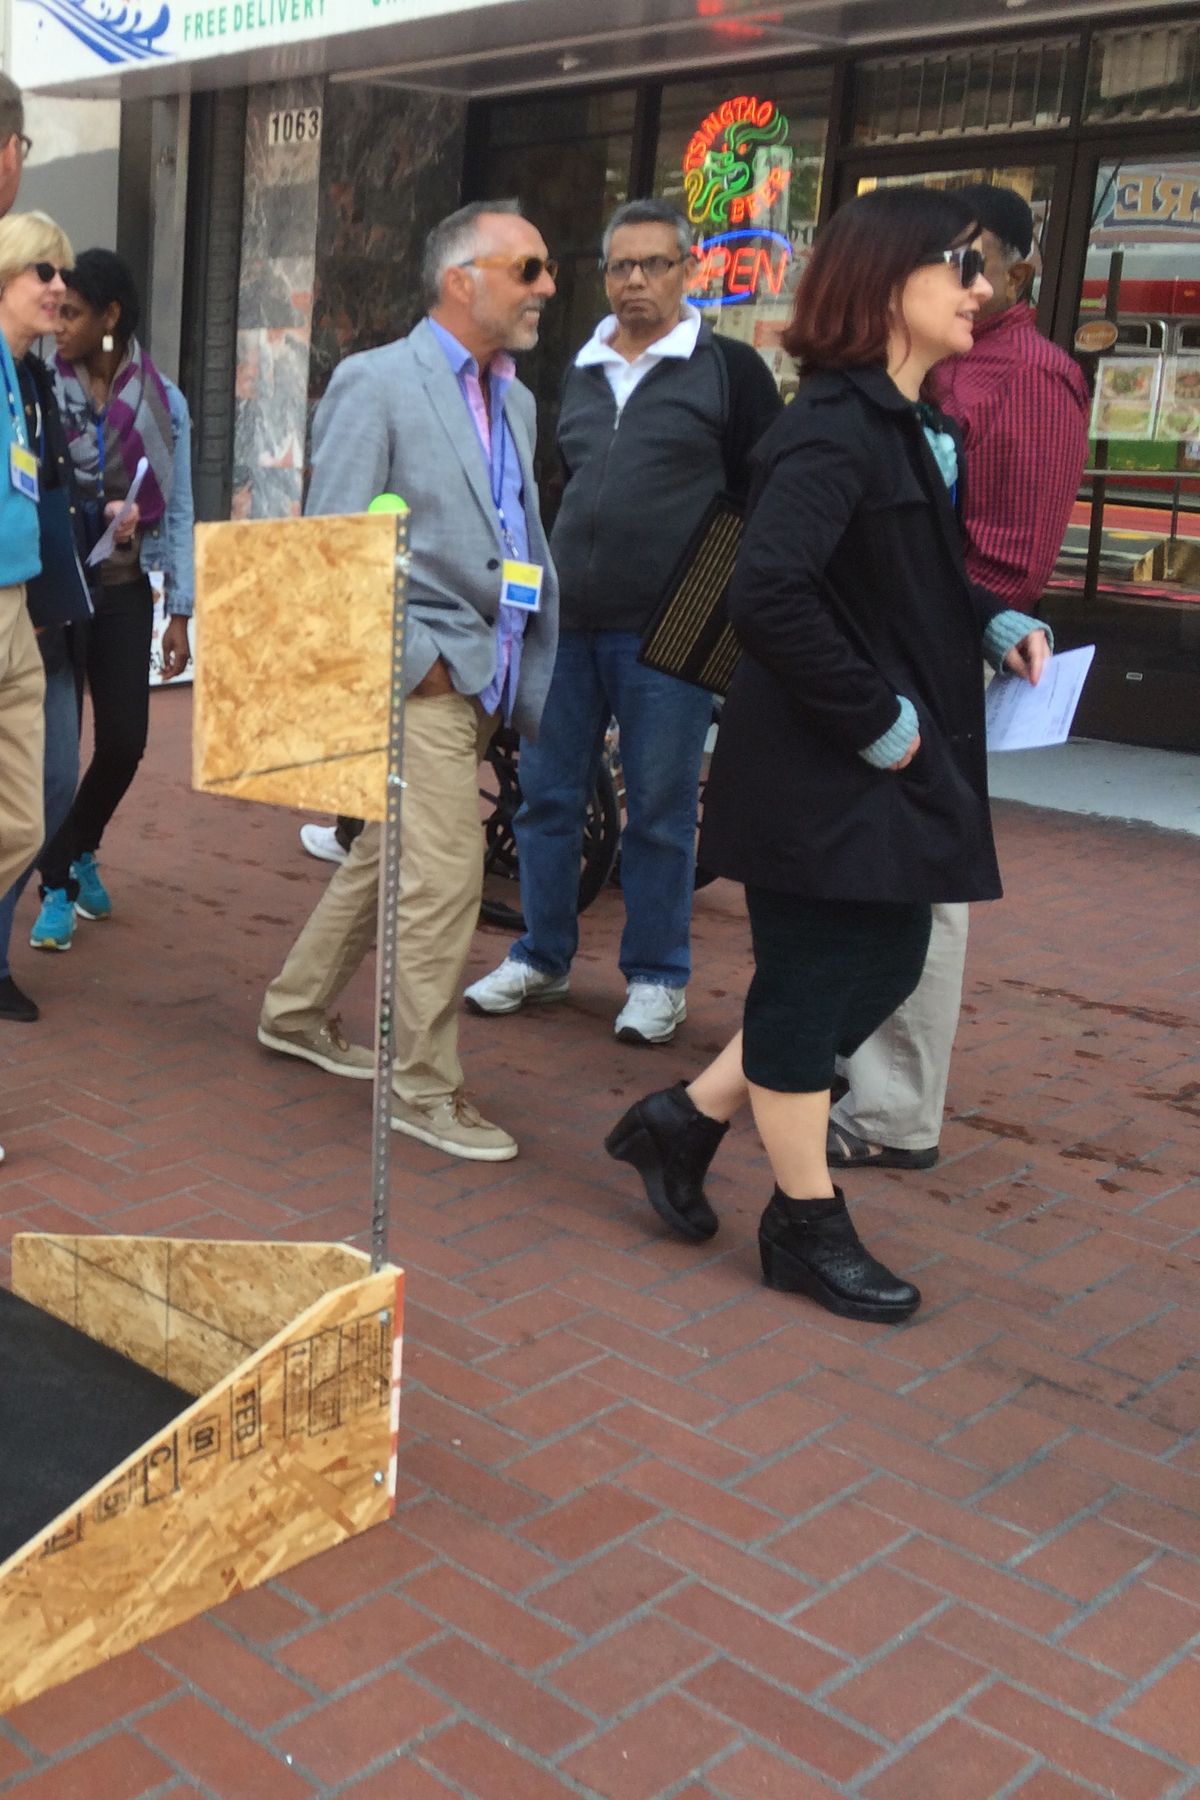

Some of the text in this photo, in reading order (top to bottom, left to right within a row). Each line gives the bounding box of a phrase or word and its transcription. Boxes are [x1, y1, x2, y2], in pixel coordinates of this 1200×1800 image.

[184, 0, 326, 42] FREE DELIVERY
[271, 110, 319, 143] 1063
[684, 96, 774, 172] TSINGTAO
[687, 245, 788, 295] OPEN
[235, 1387, 257, 1442] FEB
